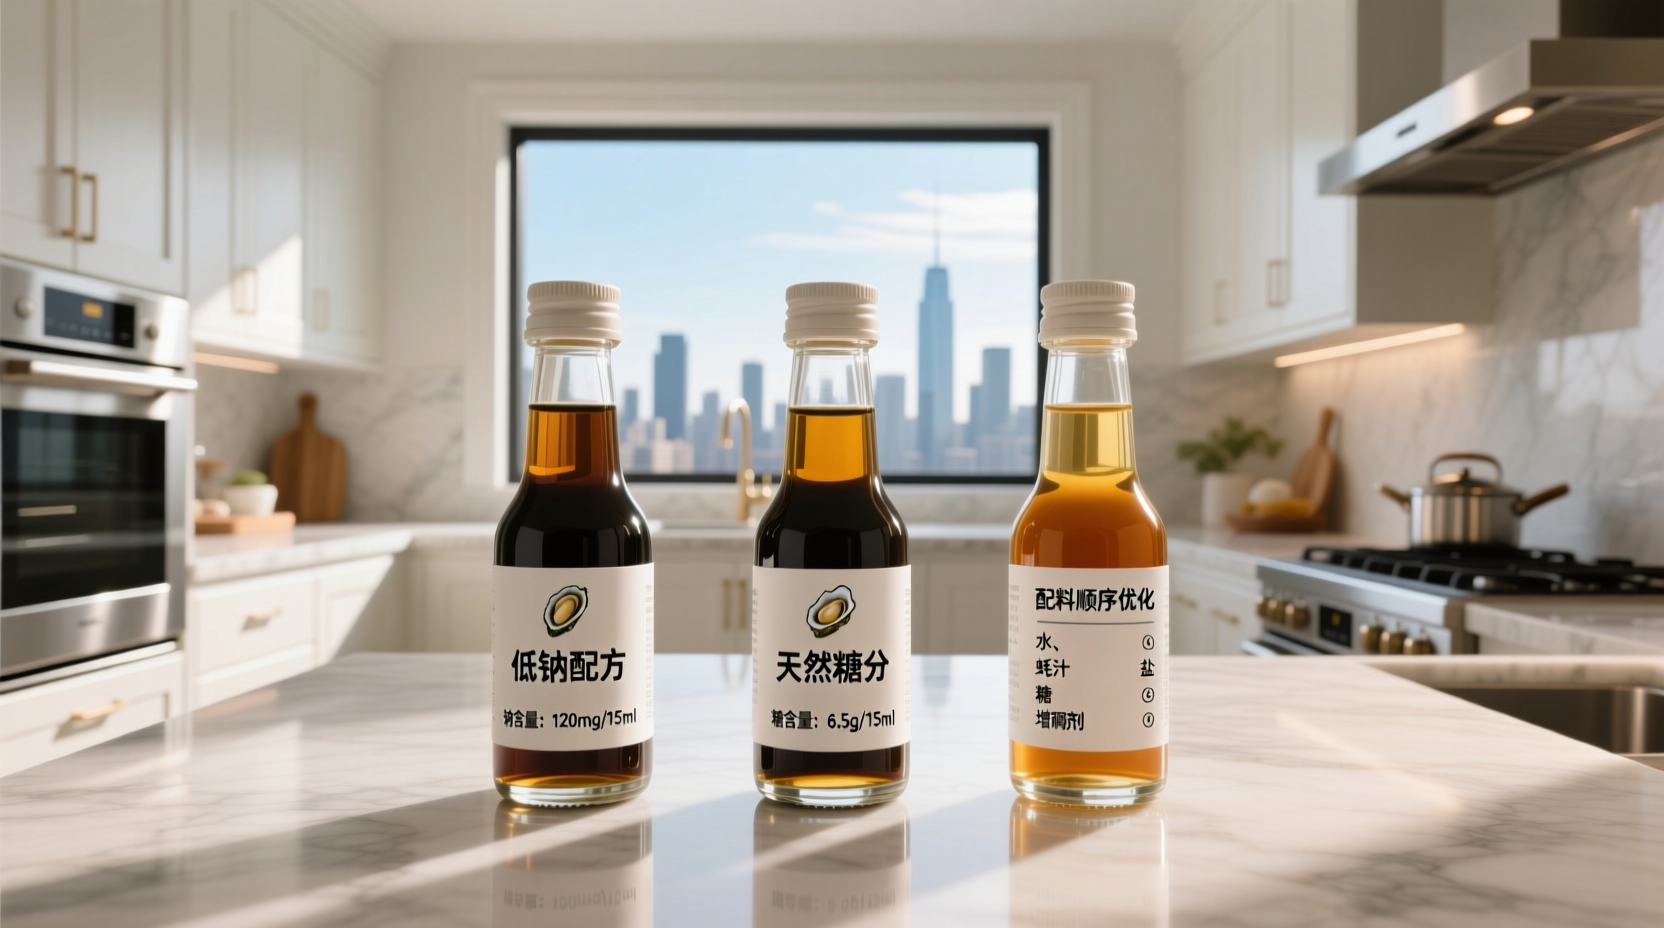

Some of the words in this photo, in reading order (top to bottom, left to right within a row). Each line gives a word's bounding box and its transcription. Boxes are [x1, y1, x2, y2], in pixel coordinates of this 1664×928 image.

[1034, 587, 1155, 612] 配料顺序优化
[511, 647, 626, 683] 低钠配方
[776, 649, 890, 684] 天然糖分
[1034, 656, 1071, 678] 蚝汁
[1139, 658, 1155, 677] 盐
[1035, 684, 1053, 704] 糖
[552, 707, 637, 731] 120mg/15ml
[827, 709, 895, 732] 6.5g/15ml
